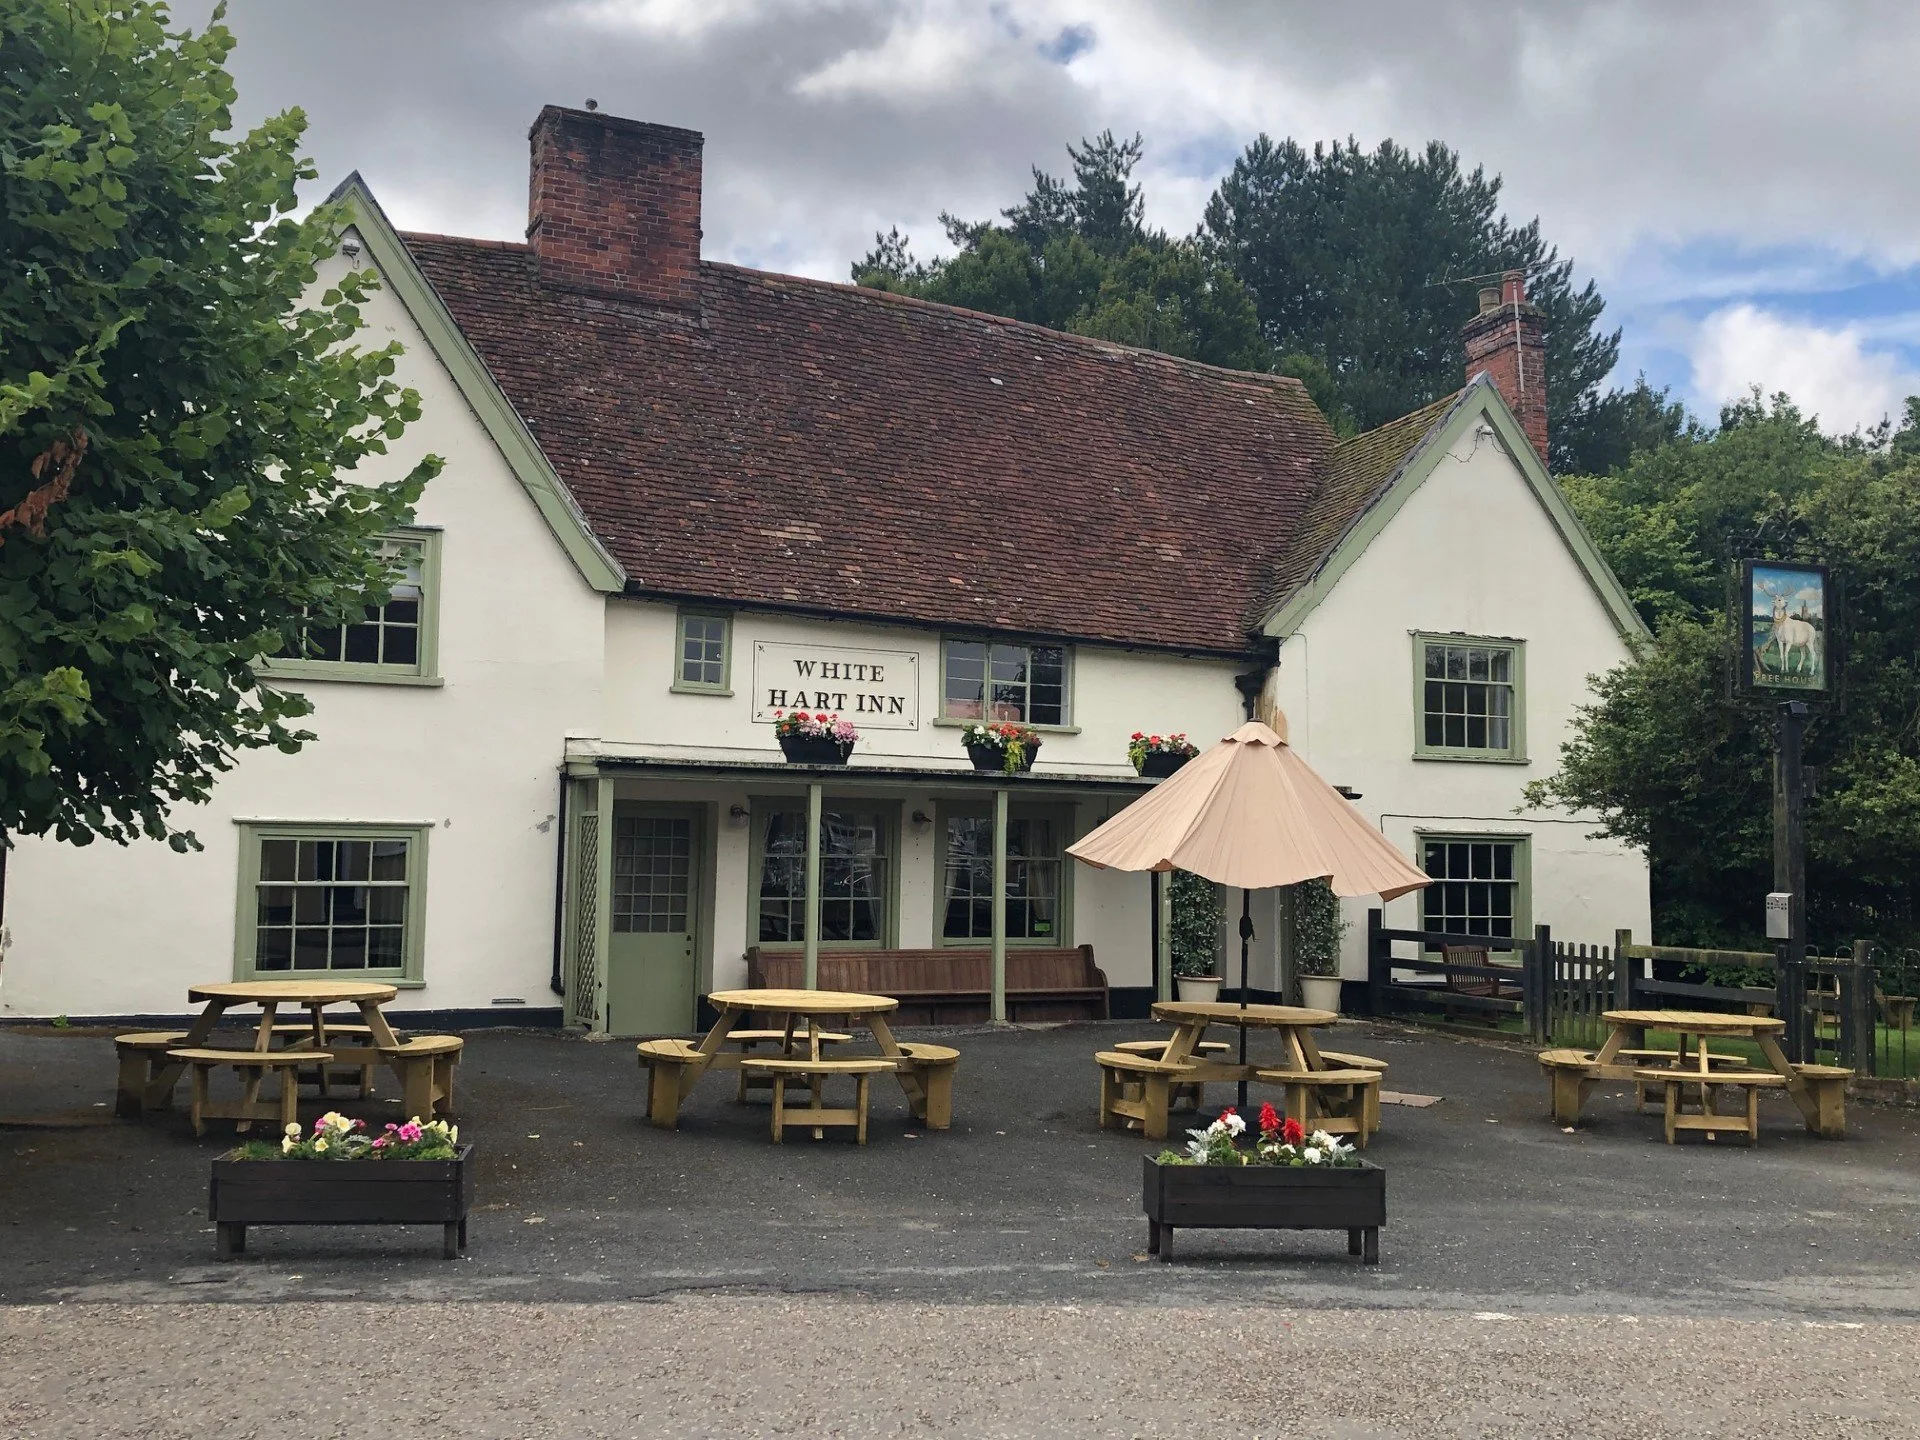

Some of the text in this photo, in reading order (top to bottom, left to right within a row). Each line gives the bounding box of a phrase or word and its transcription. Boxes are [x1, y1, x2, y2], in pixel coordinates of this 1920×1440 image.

[793, 659, 884, 682] WHITE
[1754, 672, 1780, 683] FREE
[767, 688, 905, 714] HART INN
